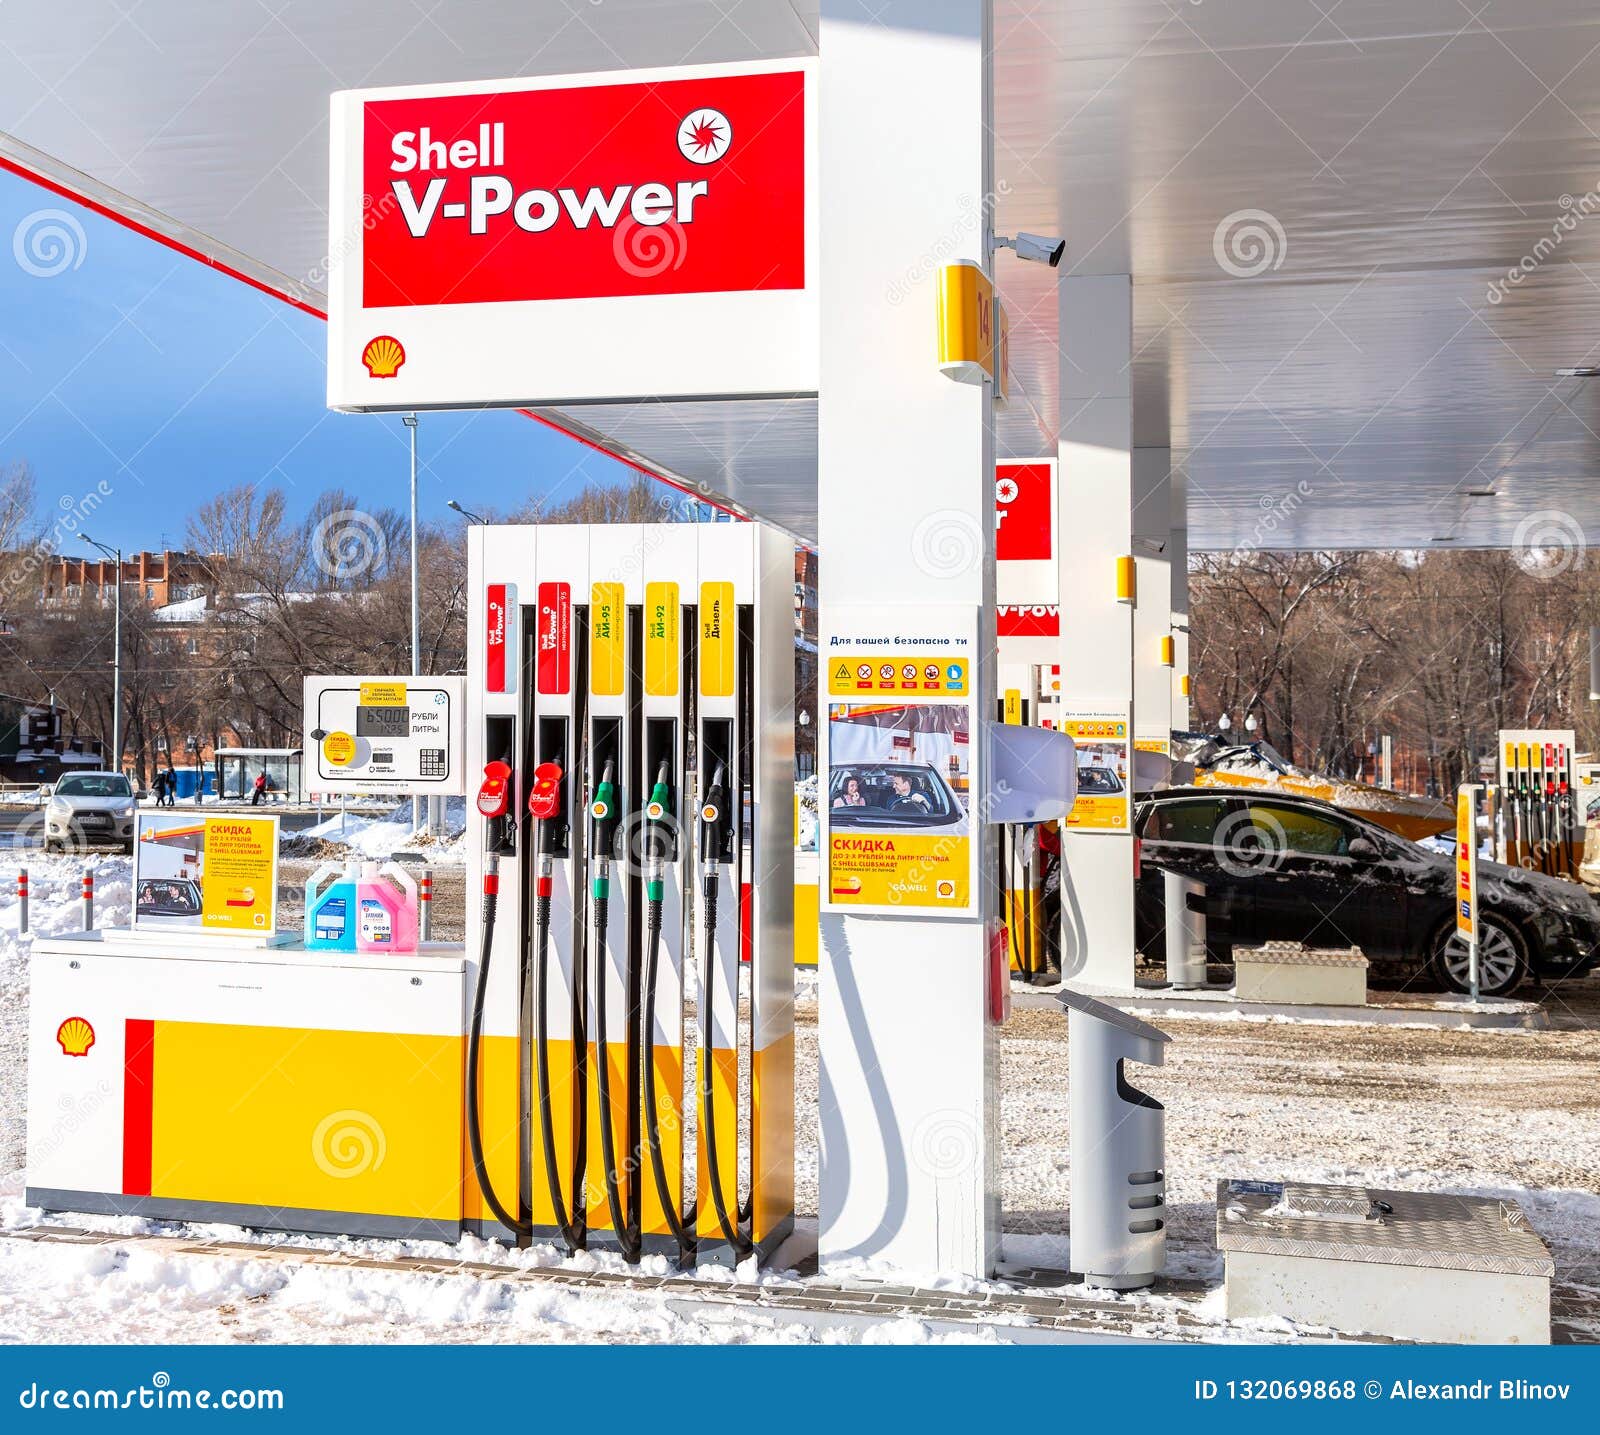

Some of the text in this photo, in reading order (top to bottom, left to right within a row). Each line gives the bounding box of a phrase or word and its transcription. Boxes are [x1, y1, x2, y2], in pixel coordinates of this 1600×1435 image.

[390, 122, 504, 172] Shell
[391, 175, 708, 238] V-Power
[977, 291, 990, 346] 14
[495, 605, 504, 645] V-Power
[548, 610, 557, 649] V-Power
[602, 605, 610, 638] АИ-95
[656, 605, 665, 638] АИ-92
[711, 600, 720, 638] Дизель
[830, 636, 851, 646] Для
[855, 636, 890, 645] вашей
[412, 712, 439, 721] РУБЛИ
[412, 725, 440, 733] ЛИТРЫ
[210, 825, 252, 836] СКИДКА
[833, 839, 896, 853] СКИДКА
[908, 884, 928, 892] WELL
